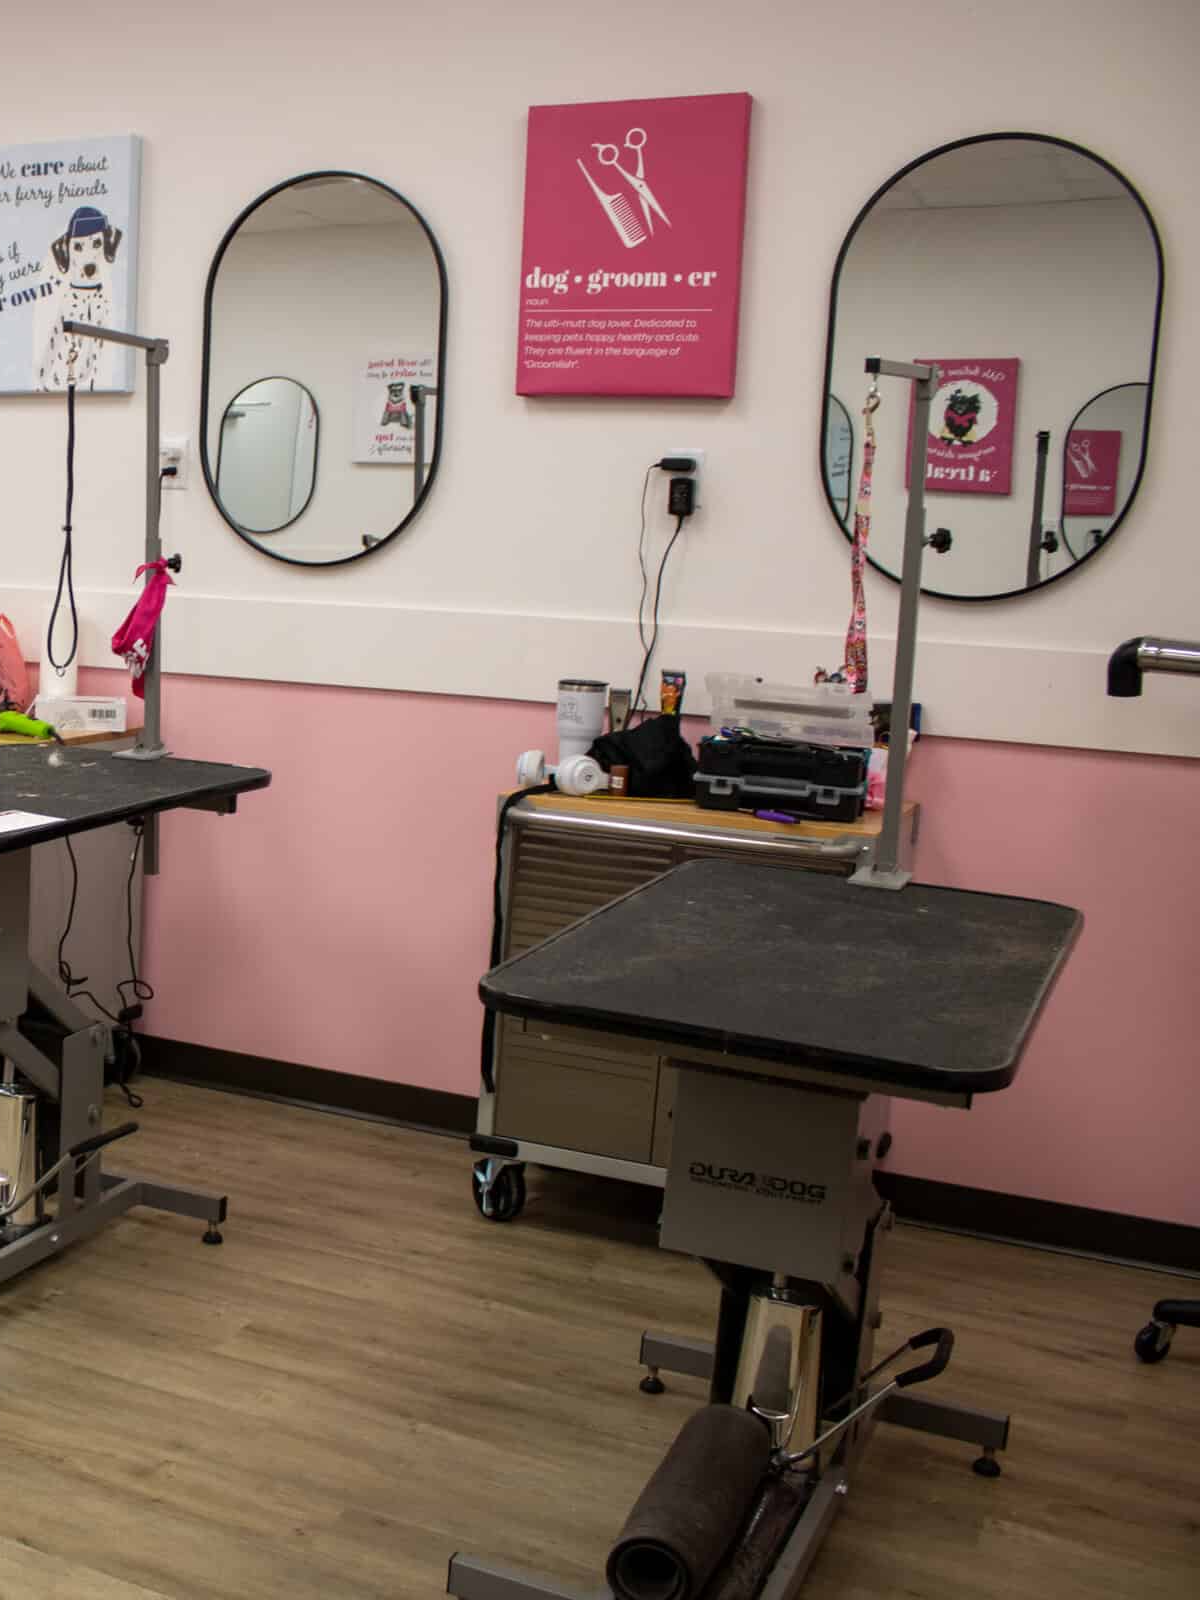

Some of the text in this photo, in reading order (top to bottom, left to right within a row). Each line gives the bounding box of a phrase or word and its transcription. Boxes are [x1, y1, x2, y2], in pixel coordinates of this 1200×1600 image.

[21, 160, 64, 177] care
[68, 155, 108, 173] about
[15, 185, 53, 208] furry
[58, 179, 108, 204] friends
[8, 241, 20, 264] if
[9, 261, 41, 280] were
[525, 266, 718, 295] dog groom er
[11, 282, 53, 306] own
[526, 297, 549, 306] noun
[527, 319, 542, 329] The
[588, 319, 606, 331] dog
[633, 318, 685, 329] Dedicated
[686, 319, 697, 329] to
[525, 333, 561, 344] keeping
[562, 334, 583, 344] pets
[617, 333, 652, 344] healthy
[654, 333, 674, 342] and
[526, 346, 681, 359] They are fluent in the language of
[689, 1161, 756, 1186] DURA
[768, 1176, 827, 1201] DOG
